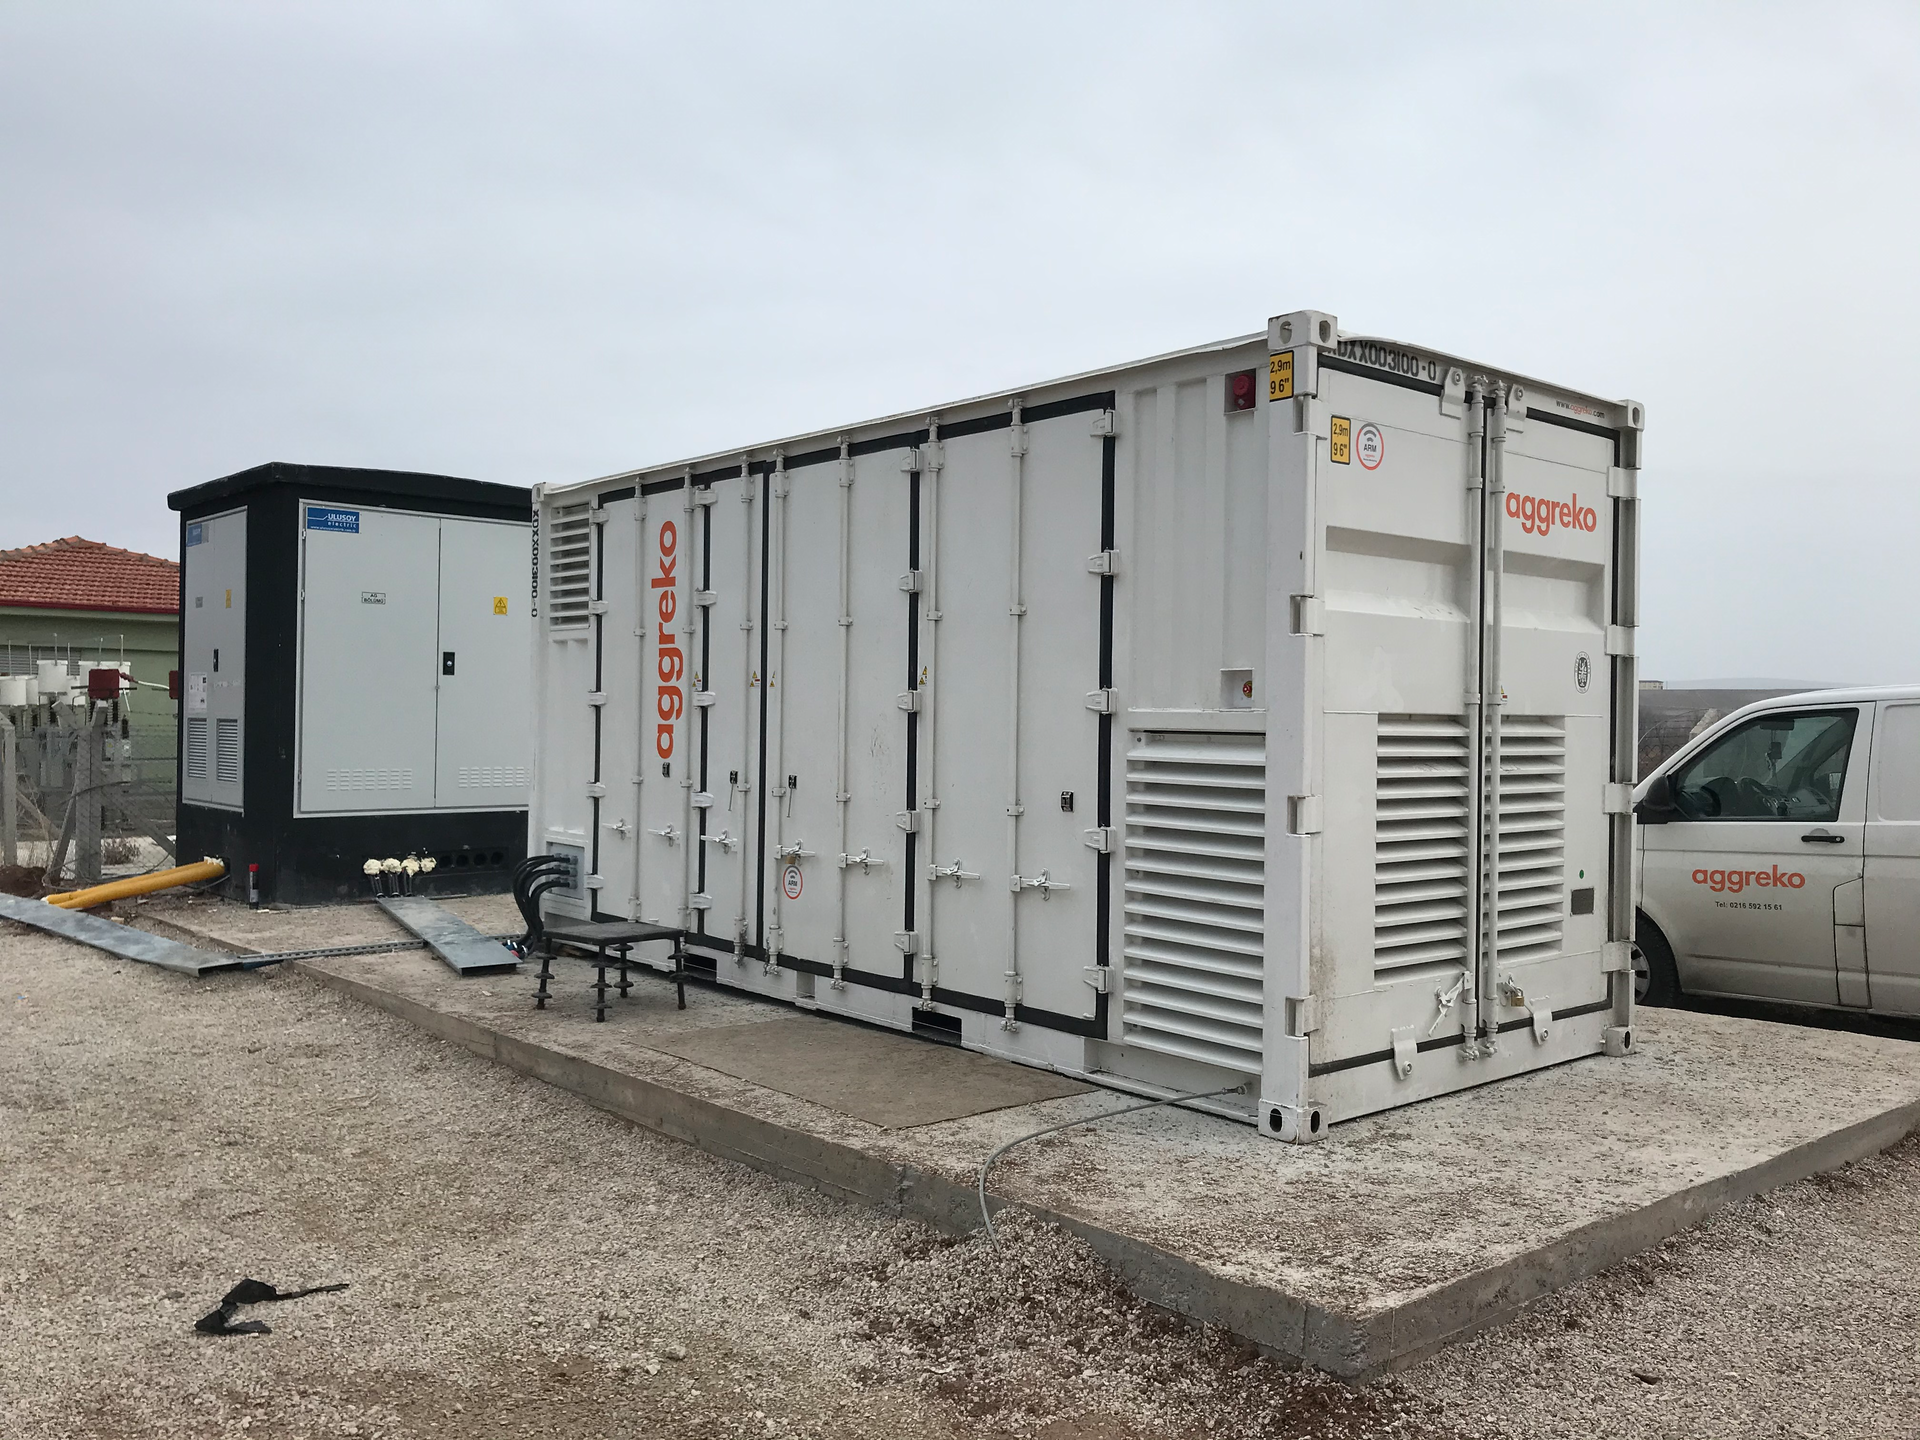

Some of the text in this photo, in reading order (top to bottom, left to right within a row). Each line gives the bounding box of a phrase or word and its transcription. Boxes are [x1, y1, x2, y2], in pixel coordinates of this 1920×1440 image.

[1270, 360, 1291, 375] 2,9m
[1328, 340, 1436, 381] DXX003100-0
[1556, 400, 1605, 419] www.aggreko.com
[1333, 423, 1349, 437] 2,9m
[1363, 444, 1377, 452] ARM
[327, 513, 356, 522] ULUSOY
[1506, 492, 1597, 537] aggreko
[651, 520, 684, 760] aggreko
[1692, 864, 1806, 893] aggreko
[1748, 902, 1762, 910] 592
